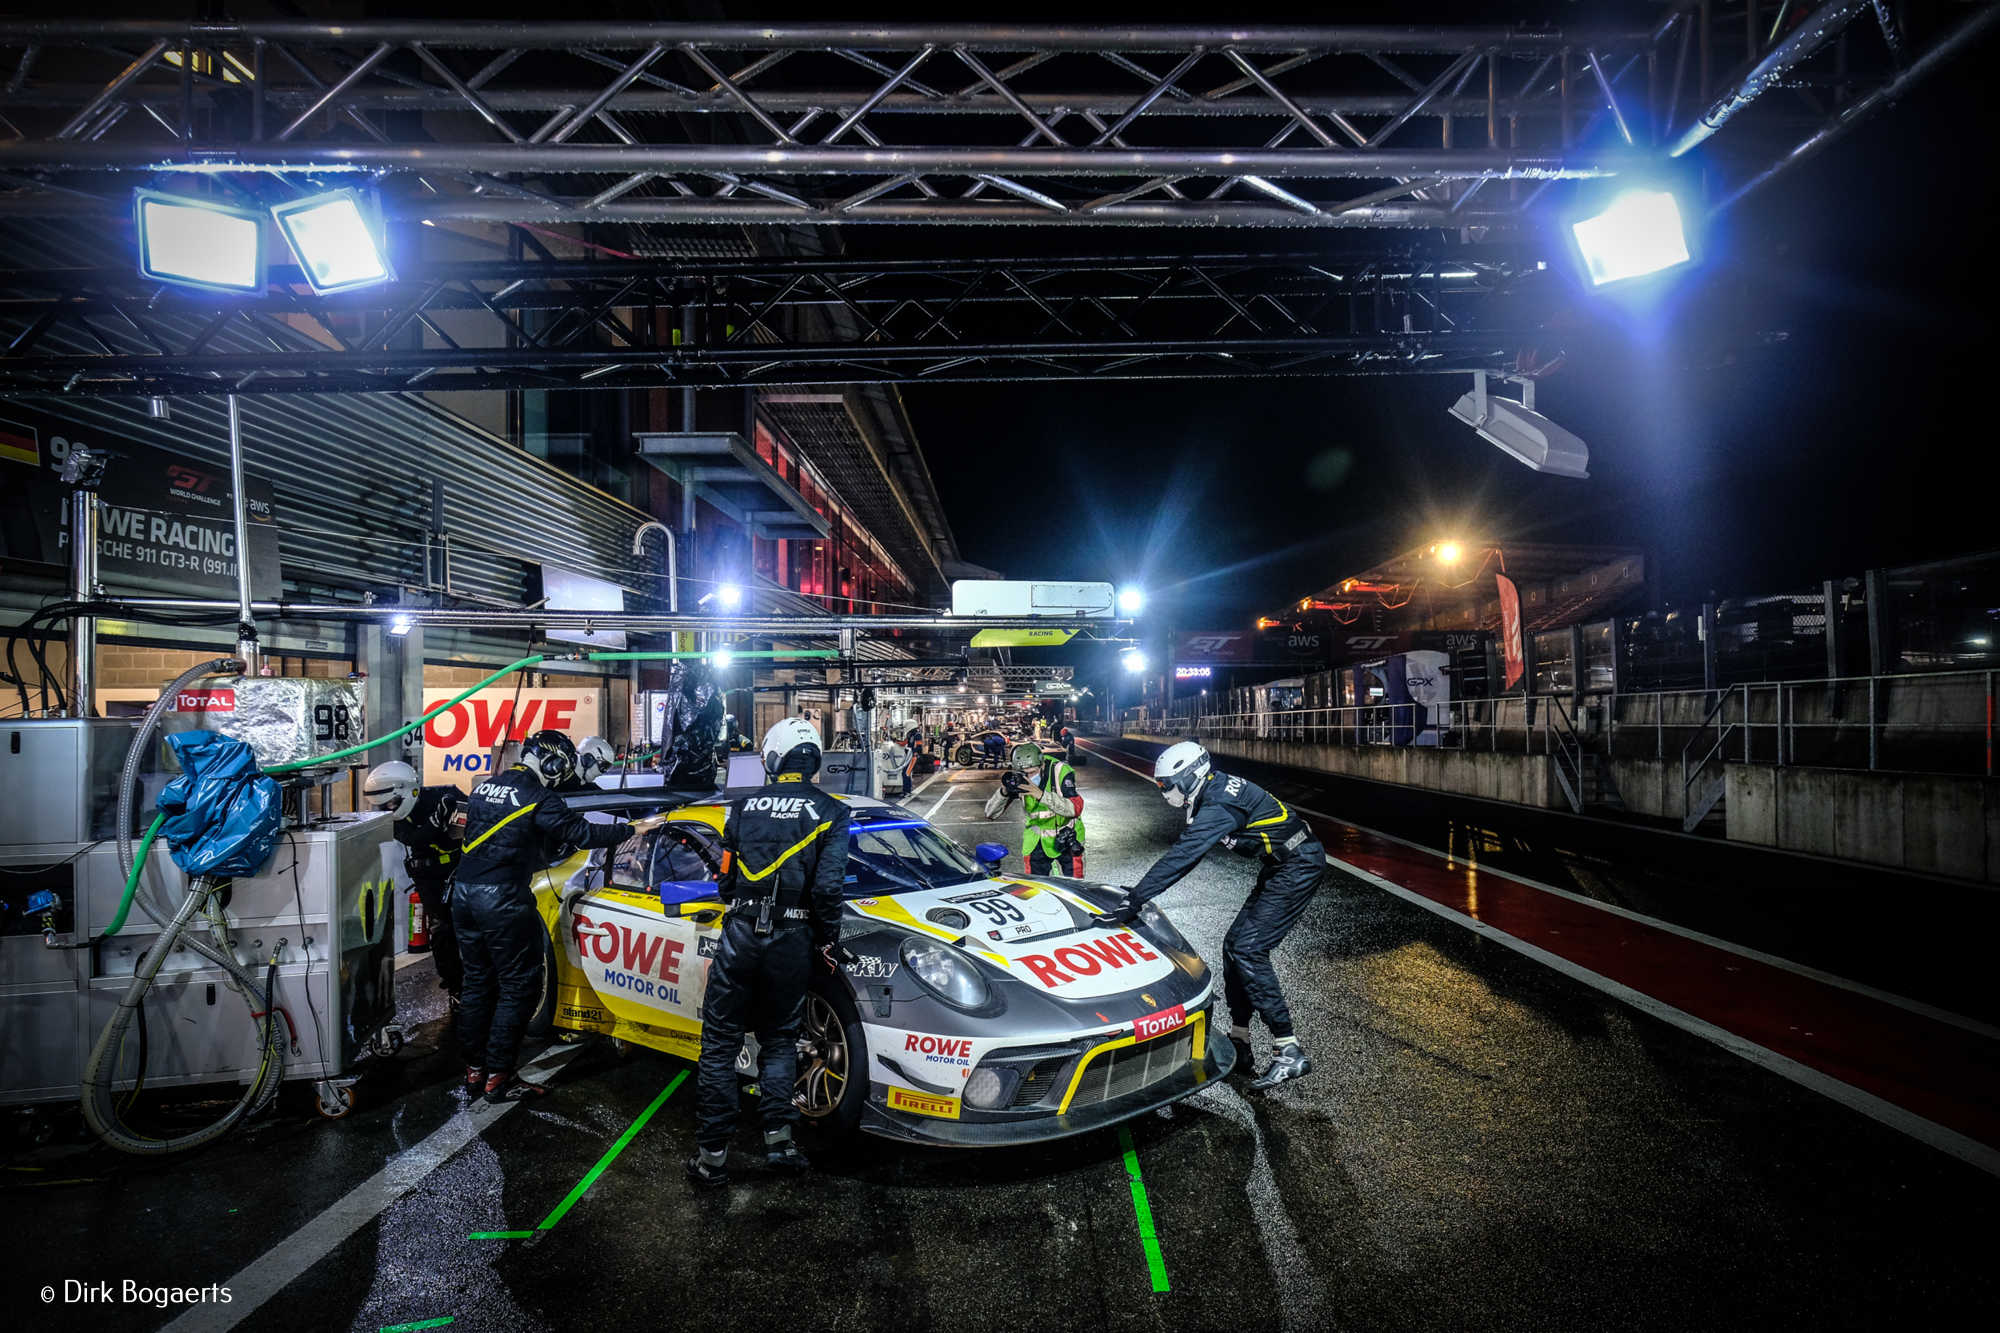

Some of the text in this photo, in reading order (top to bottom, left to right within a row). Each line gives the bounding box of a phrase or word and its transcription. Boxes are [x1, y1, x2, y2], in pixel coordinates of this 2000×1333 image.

[170, 487, 191, 499] WORLD
[191, 492, 222, 506] CHALLENGE
[249, 498, 271, 514] aws
[150, 515, 235, 557] RACING
[58, 530, 132, 560] PSCHE
[136, 546, 157, 564] 911
[160, 550, 200, 571] GT3-R
[1287, 634, 1320, 647] aws
[1446, 633, 1478, 646] aws
[1407, 678, 1433, 687] GPX
[314, 704, 349, 741] 98
[424, 699, 576, 749] OWE
[404, 721, 424, 747] 34
[442, 753, 491, 772] MOT
[743, 796, 806, 813] ROWE
[770, 811, 800, 819] RACING
[969, 898, 1025, 926] 99
[1015, 925, 1032, 935] PRO
[571, 912, 685, 985] ROWE
[853, 962, 899, 978] KW
[1012, 932, 1160, 989] ROWE
[604, 968, 682, 1005] MOTOR OIL
[904, 1033, 973, 1058] ROWE
[926, 1054, 955, 1065] MOTOR
[894, 1091, 954, 1114] PIRELLI
